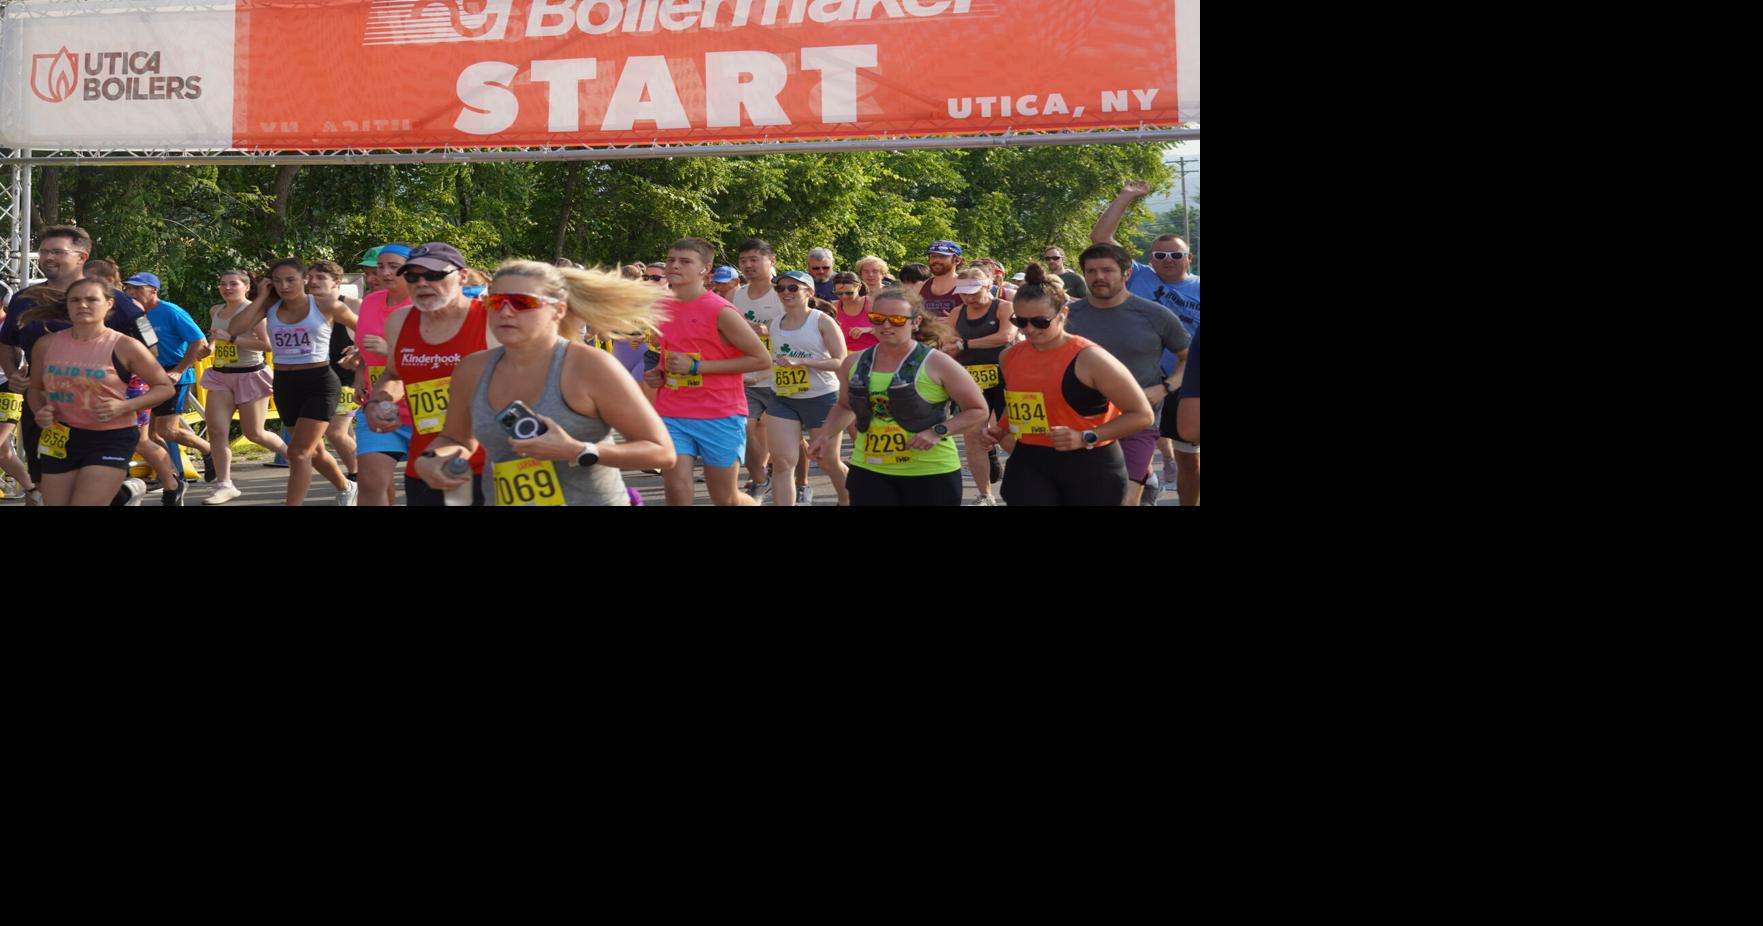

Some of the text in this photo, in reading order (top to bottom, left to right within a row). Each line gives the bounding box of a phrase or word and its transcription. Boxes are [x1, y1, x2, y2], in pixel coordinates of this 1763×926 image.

[84, 51, 161, 75] UTICA
[83, 75, 202, 101] BOILERS
[453, 43, 878, 135] START
[947, 88, 1160, 119] UTICA, NY
[274, 331, 312, 348] 5214
[402, 353, 461, 364] Kinderhook
[48, 364, 107, 380] PAID TO
[775, 369, 809, 386] 6512
[969, 368, 998, 383] 358
[410, 387, 450, 416] 705
[495, 469, 556, 505] 069
